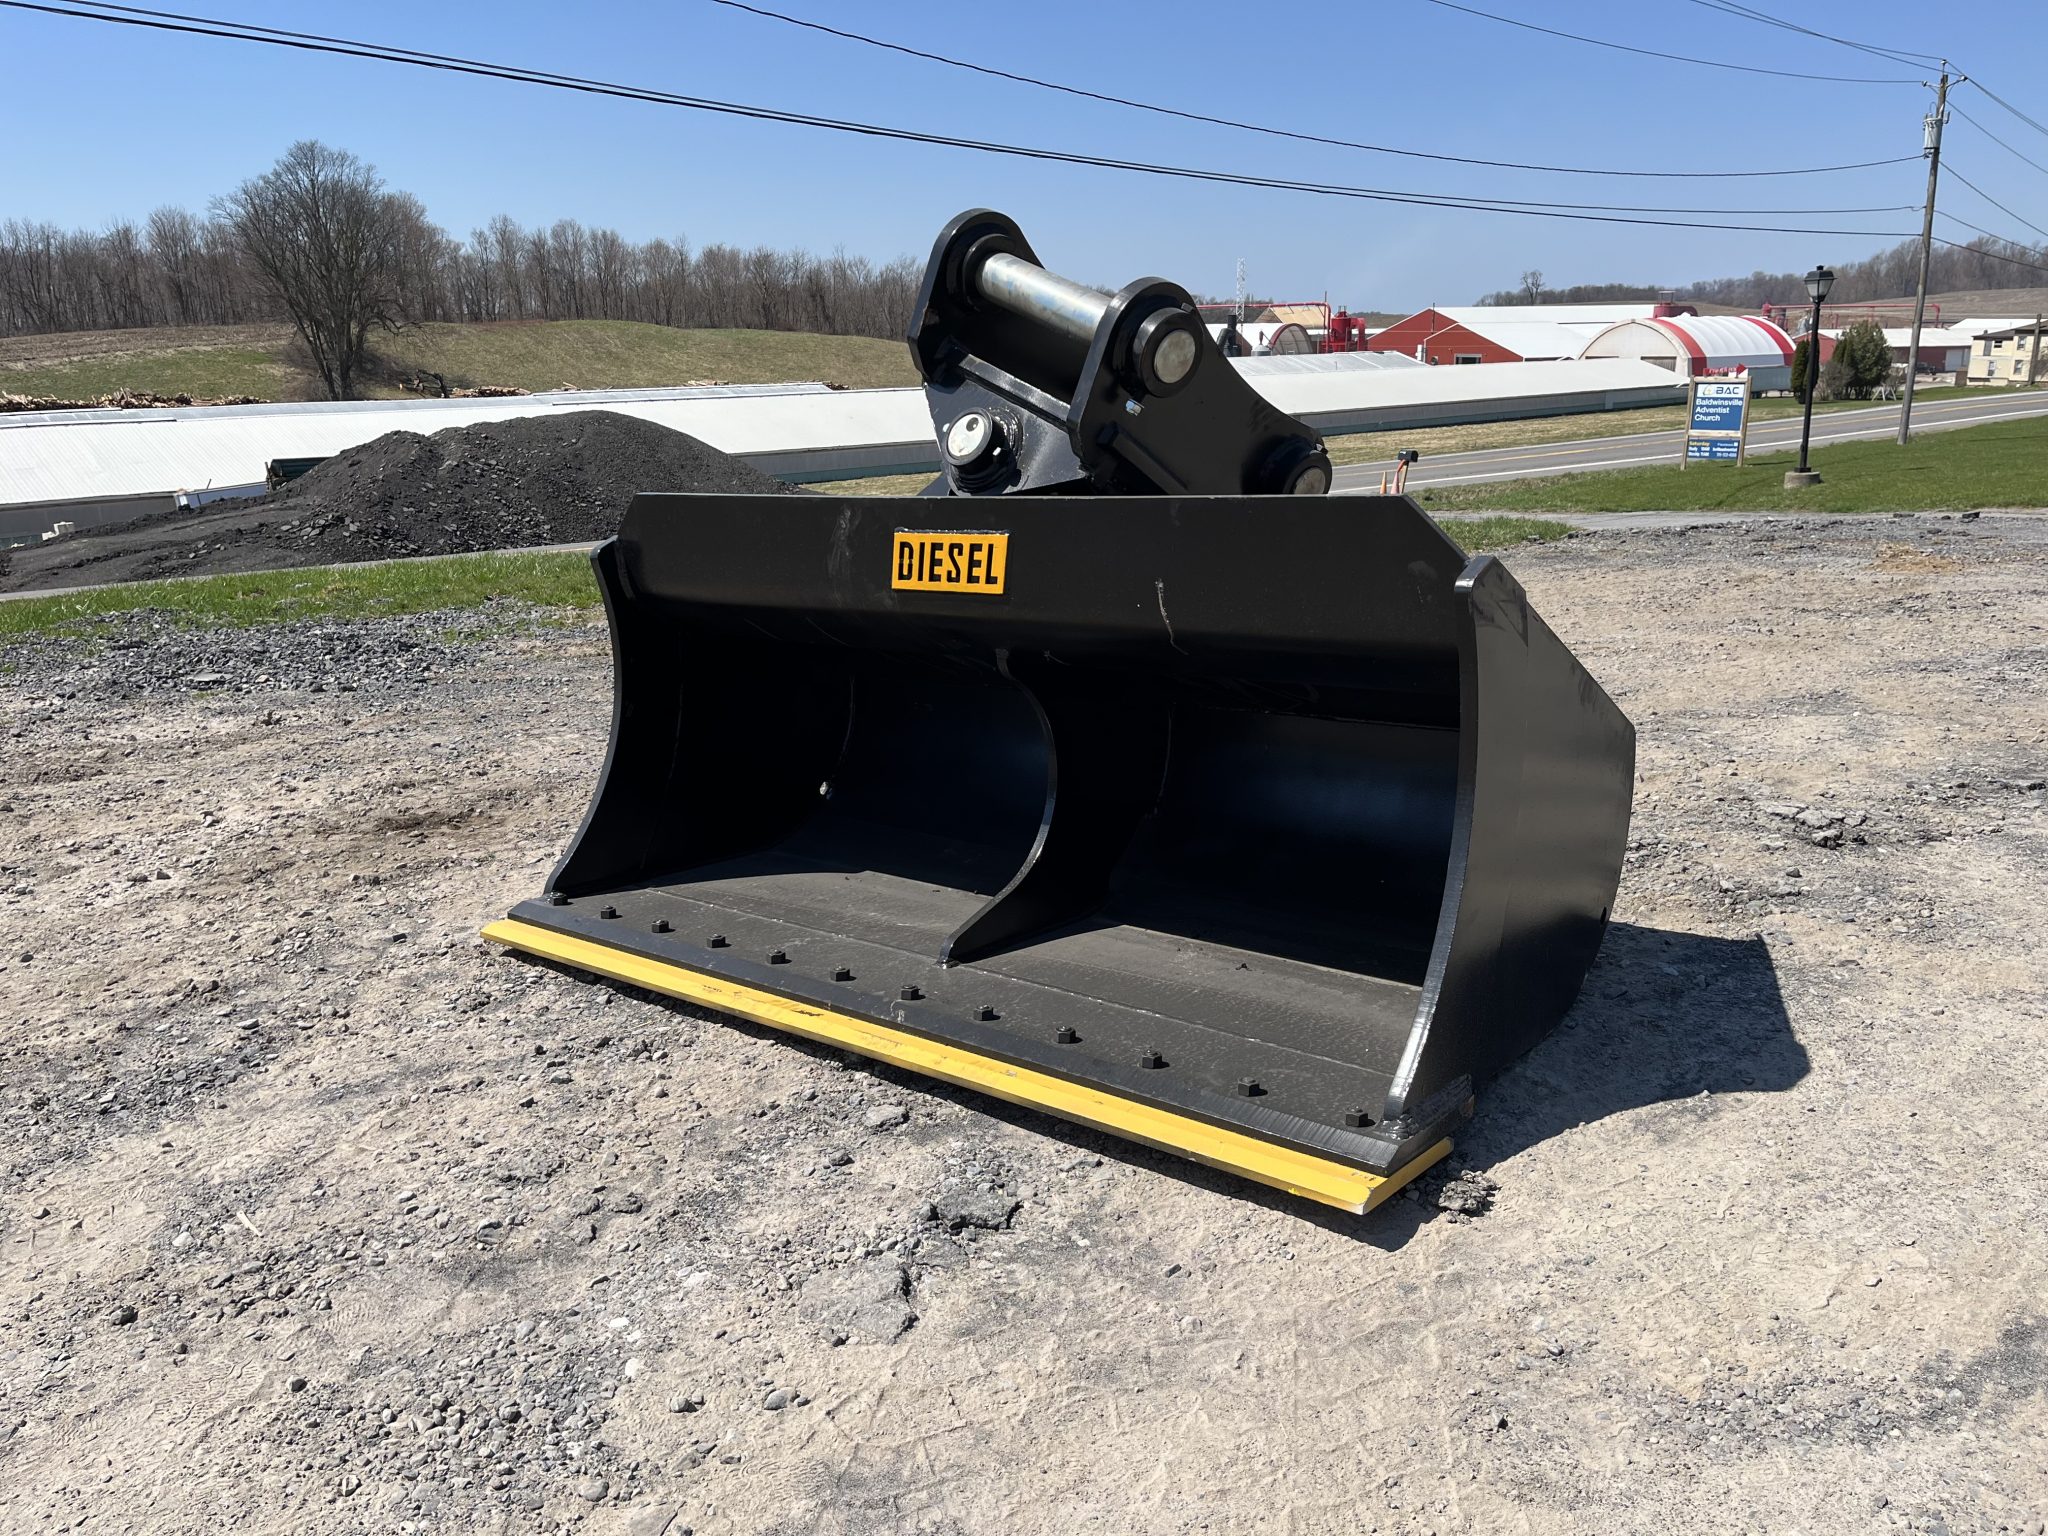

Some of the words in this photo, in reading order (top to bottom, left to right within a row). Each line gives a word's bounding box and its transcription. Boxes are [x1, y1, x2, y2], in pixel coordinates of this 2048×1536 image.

[1716, 386, 1740, 394] BAC
[1696, 398, 1743, 406] Baldwinsville
[898, 541, 998, 585] DIESEL
